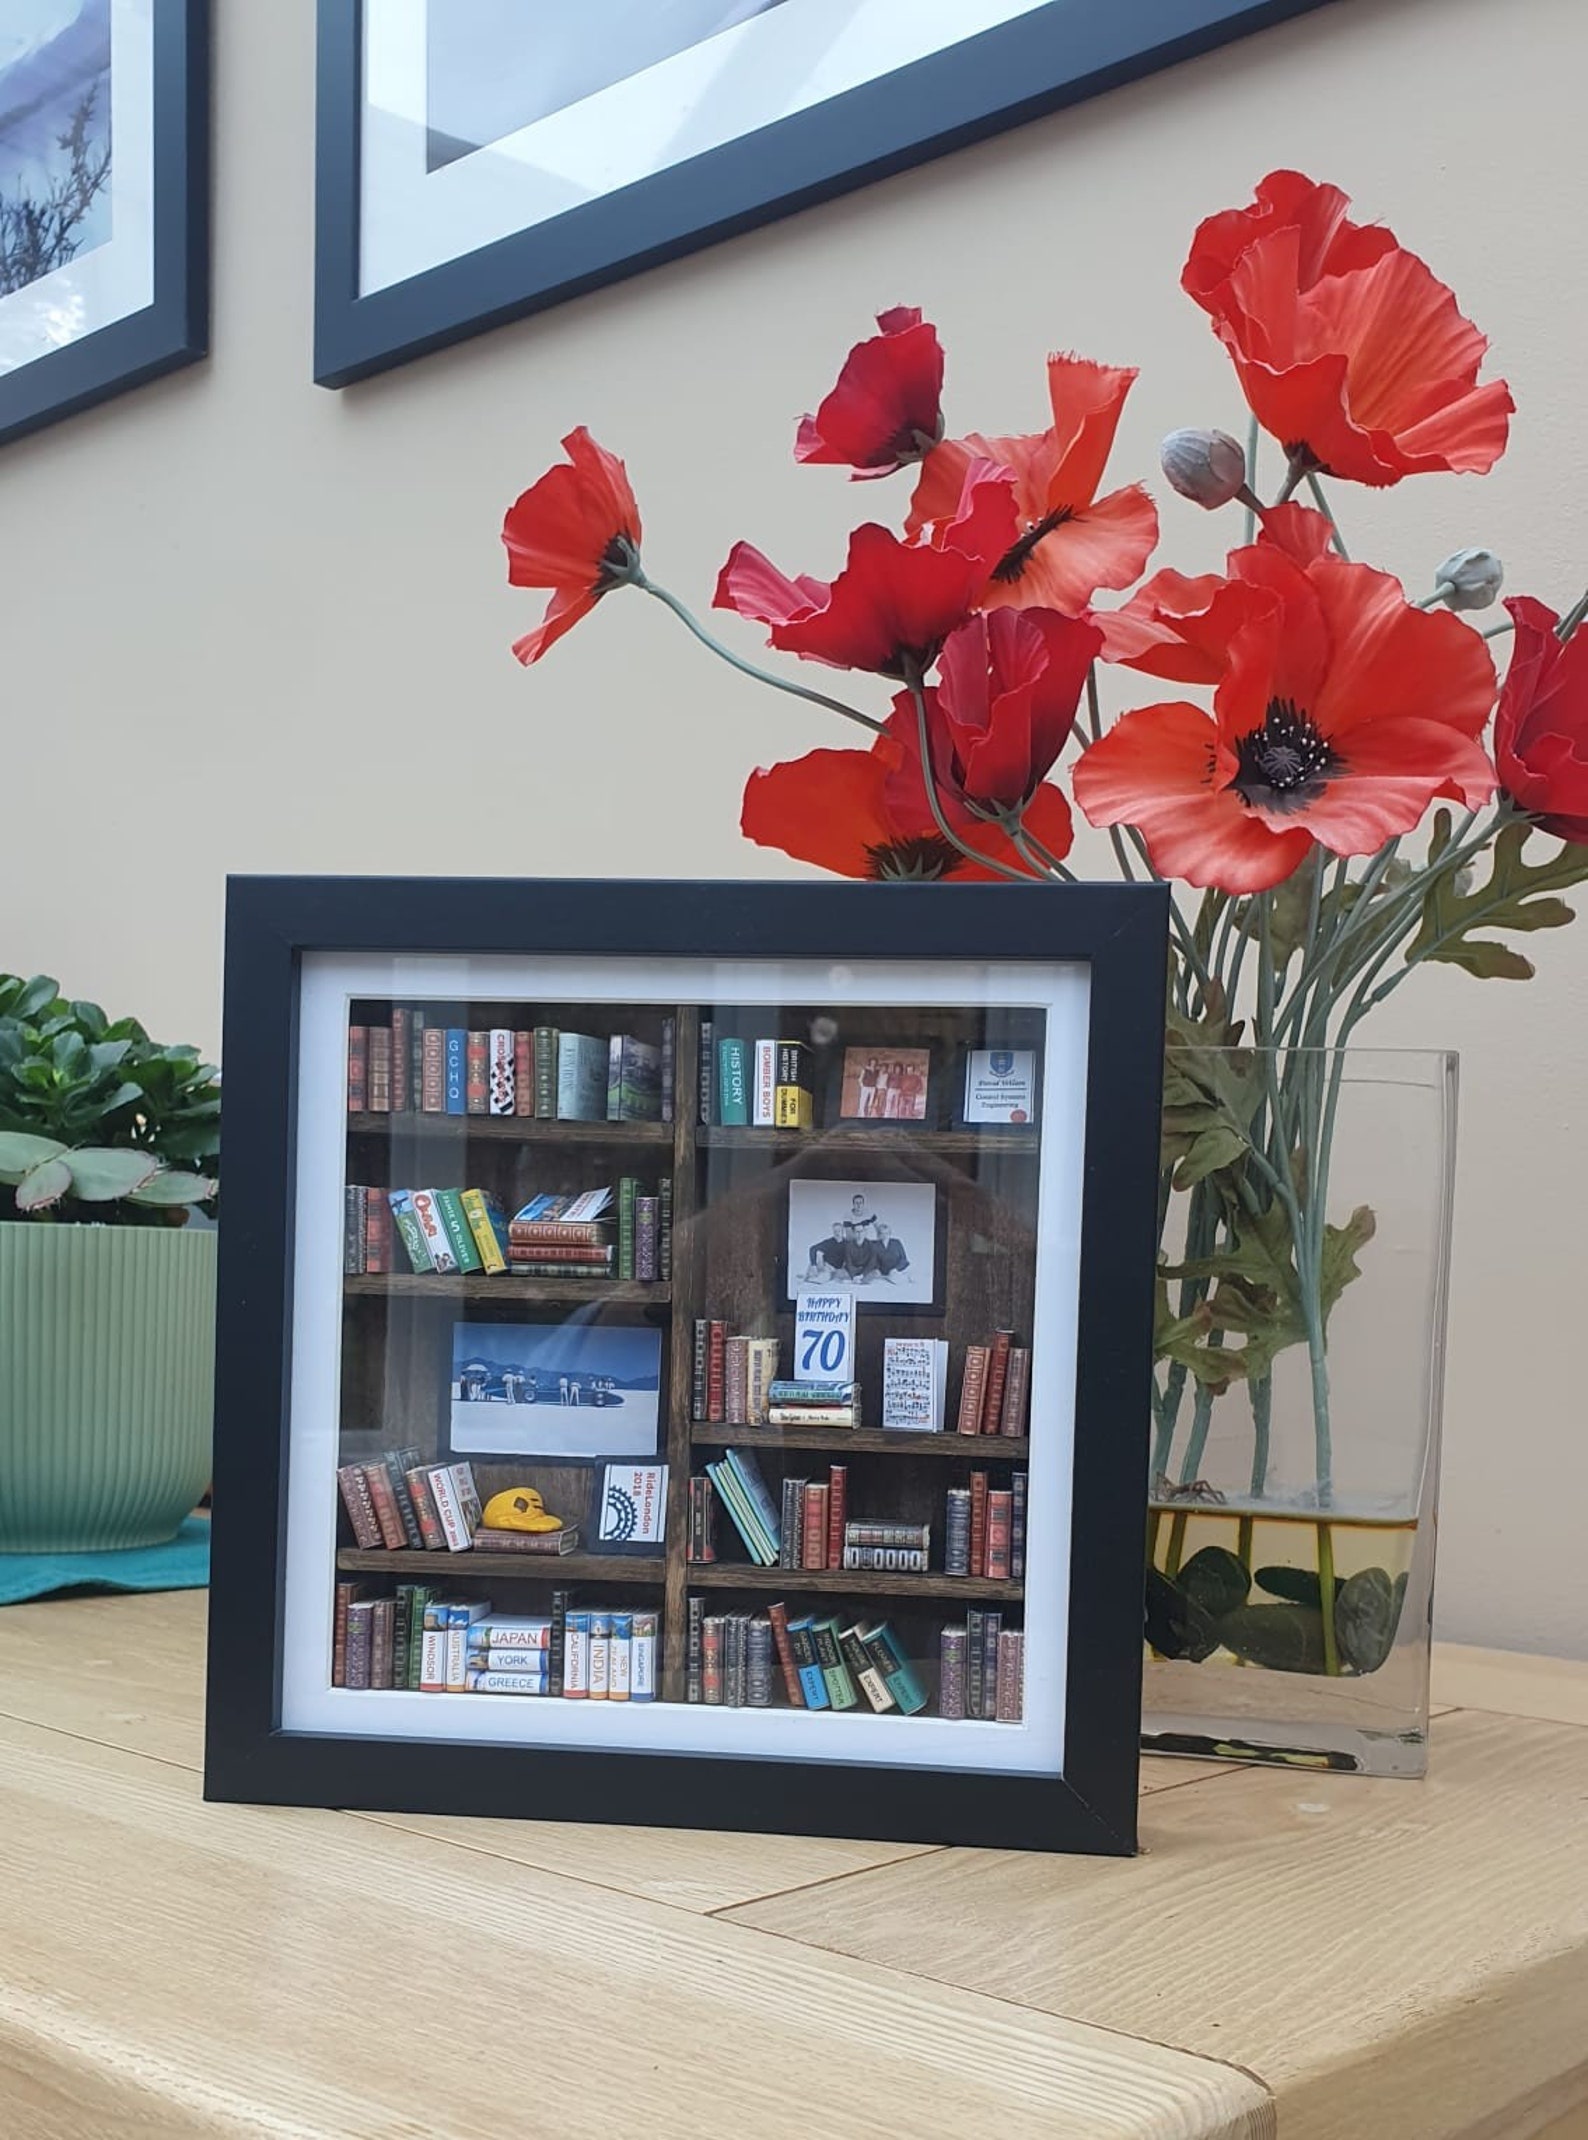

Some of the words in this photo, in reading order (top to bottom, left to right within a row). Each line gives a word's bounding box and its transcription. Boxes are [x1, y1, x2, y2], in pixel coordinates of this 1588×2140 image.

[730, 1047, 743, 1105] HISTORY
[762, 1045, 772, 1088] BOMBER
[790, 1049, 798, 1081] BRITISH
[762, 1091, 771, 1118] BOYS
[455, 1233, 471, 1264] OLIVER
[798, 1311, 849, 1323] BIRTHDAY
[807, 1297, 842, 1310] HAPPY
[802, 1329, 845, 1372] 70
[433, 1473, 449, 1508] WORLD
[443, 1508, 456, 1529] CUP
[642, 1472, 656, 1535] RideLondon
[425, 1635, 436, 1680] WINDSOR
[451, 1631, 460, 1681] AUSTRALIA
[491, 1632, 538, 1645] JAPAN
[497, 1655, 528, 1666] YORK
[570, 1632, 579, 1689] CALIFORNIA
[593, 1644, 605, 1684] INDIA
[488, 1678, 535, 1689] GREECE
